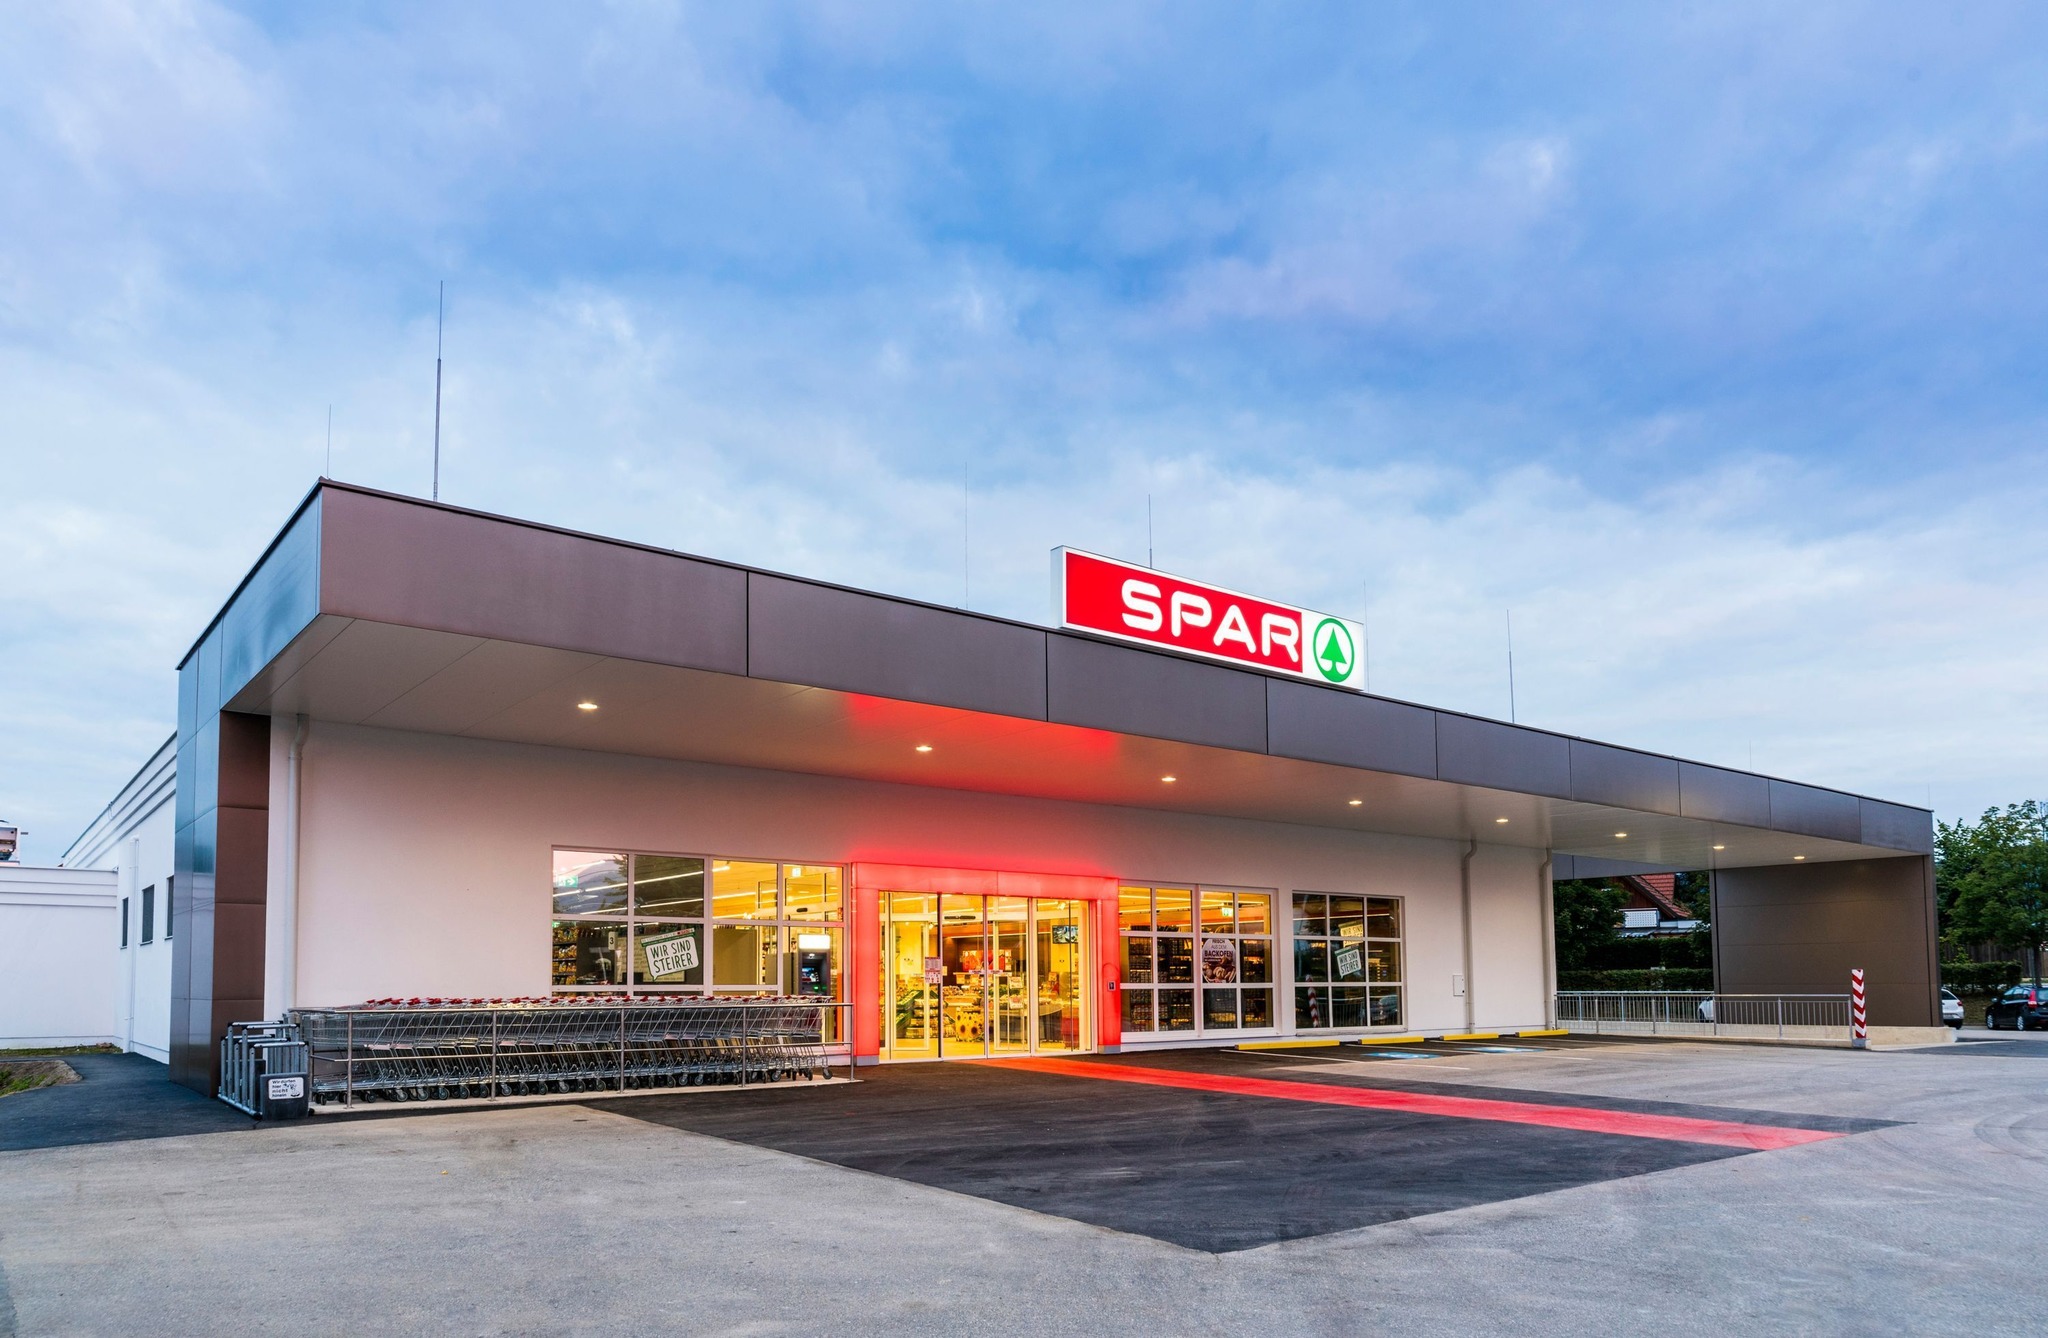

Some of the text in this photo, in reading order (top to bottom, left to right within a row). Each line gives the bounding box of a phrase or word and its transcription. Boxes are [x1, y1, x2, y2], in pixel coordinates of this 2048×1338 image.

[1122, 579, 1299, 663] SPAR
[609, 936, 614, 945] 3
[650, 939, 691, 959] WIR SIND
[653, 952, 694, 973] STEIRER
[1339, 954, 1348, 964] WIR
[1348, 950, 1358, 962] SIND
[1340, 959, 1360, 975] STEIRER
